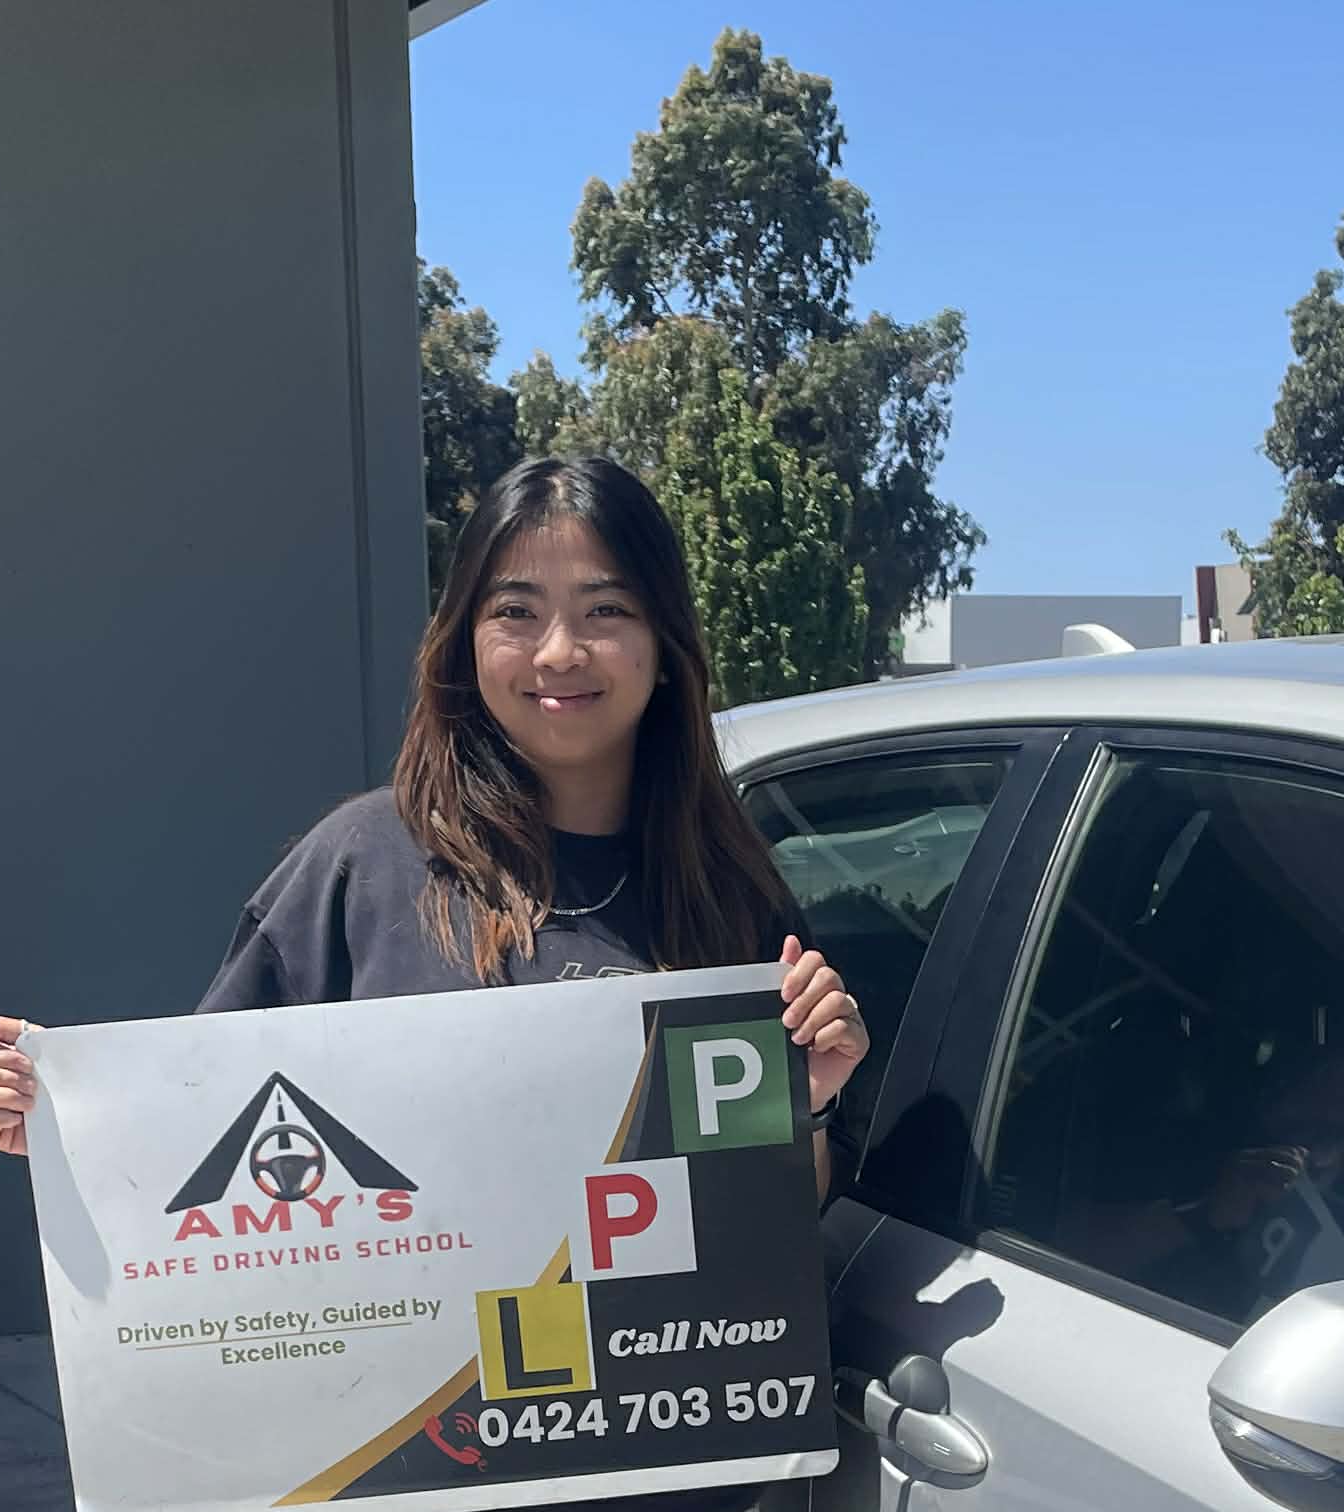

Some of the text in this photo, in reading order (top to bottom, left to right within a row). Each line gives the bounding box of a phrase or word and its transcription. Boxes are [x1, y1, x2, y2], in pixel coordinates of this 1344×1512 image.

[692, 1037, 763, 1135] P
[174, 1190, 414, 1241] AMY'S
[584, 1172, 658, 1271] P
[123, 1231, 473, 1280] SAFE DRIVING SCHOOL
[117, 1297, 442, 1344] Driven by Safety, Guided by
[497, 1295, 573, 1391] L
[608, 1317, 787, 1358] Call Now
[221, 1338, 346, 1365] Excellence
[478, 1375, 816, 1448] 0424 703 507
